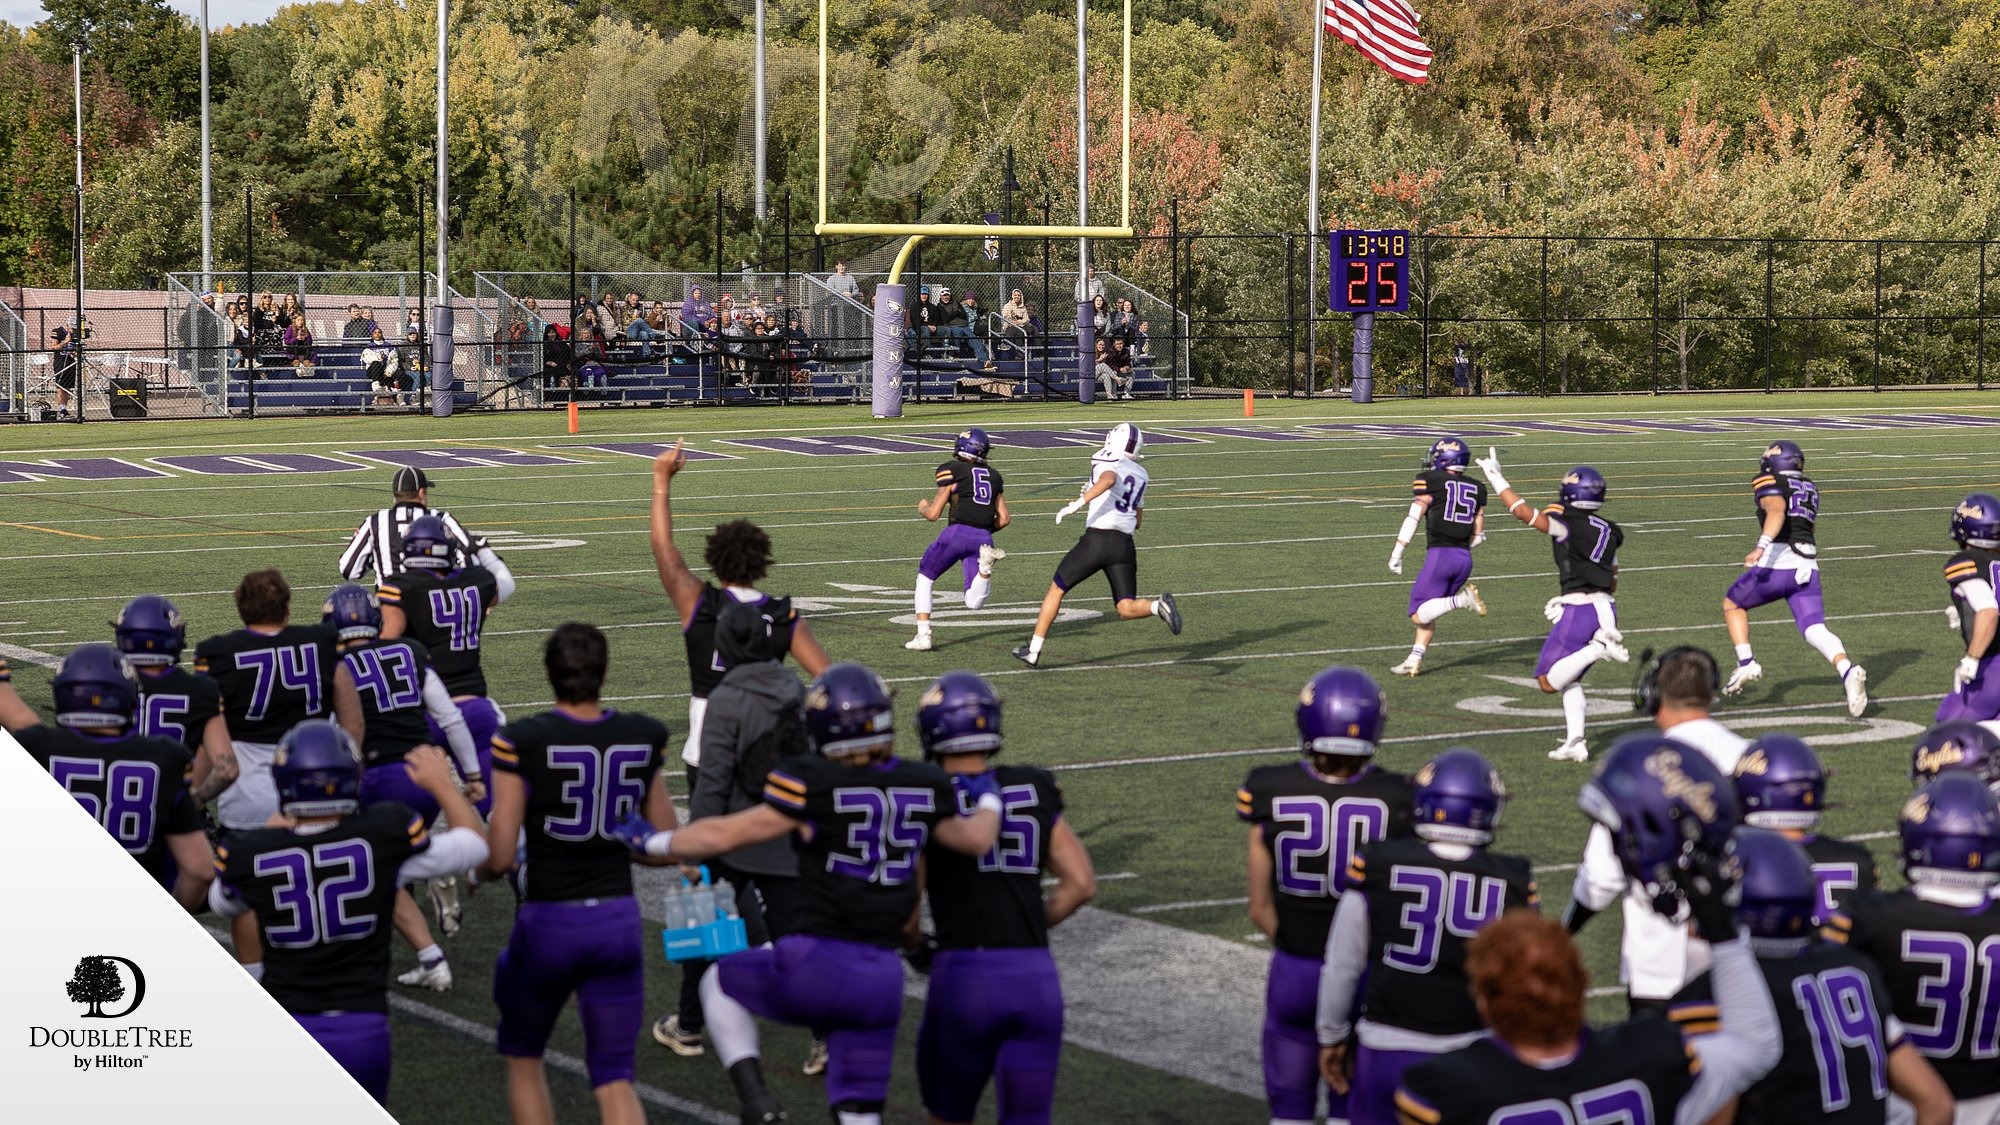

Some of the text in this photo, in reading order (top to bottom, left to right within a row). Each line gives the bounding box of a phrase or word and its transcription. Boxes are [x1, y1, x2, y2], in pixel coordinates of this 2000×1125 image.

[1348, 262, 1397, 304] 25
[1349, 235, 1404, 256] 13:48
[971, 467, 992, 506] 6
[1443, 480, 1478, 524] 15
[1588, 515, 1612, 563] 7
[428, 585, 481, 651] 41
[234, 642, 322, 720] 74
[344, 643, 422, 713] 43
[49, 755, 160, 854] 58
[544, 744, 653, 841] 36
[825, 787, 936, 885] 35
[1272, 796, 1389, 898] 20
[254, 837, 377, 949] 32
[1382, 864, 1507, 974] 34
[1792, 967, 1890, 1113] 19
